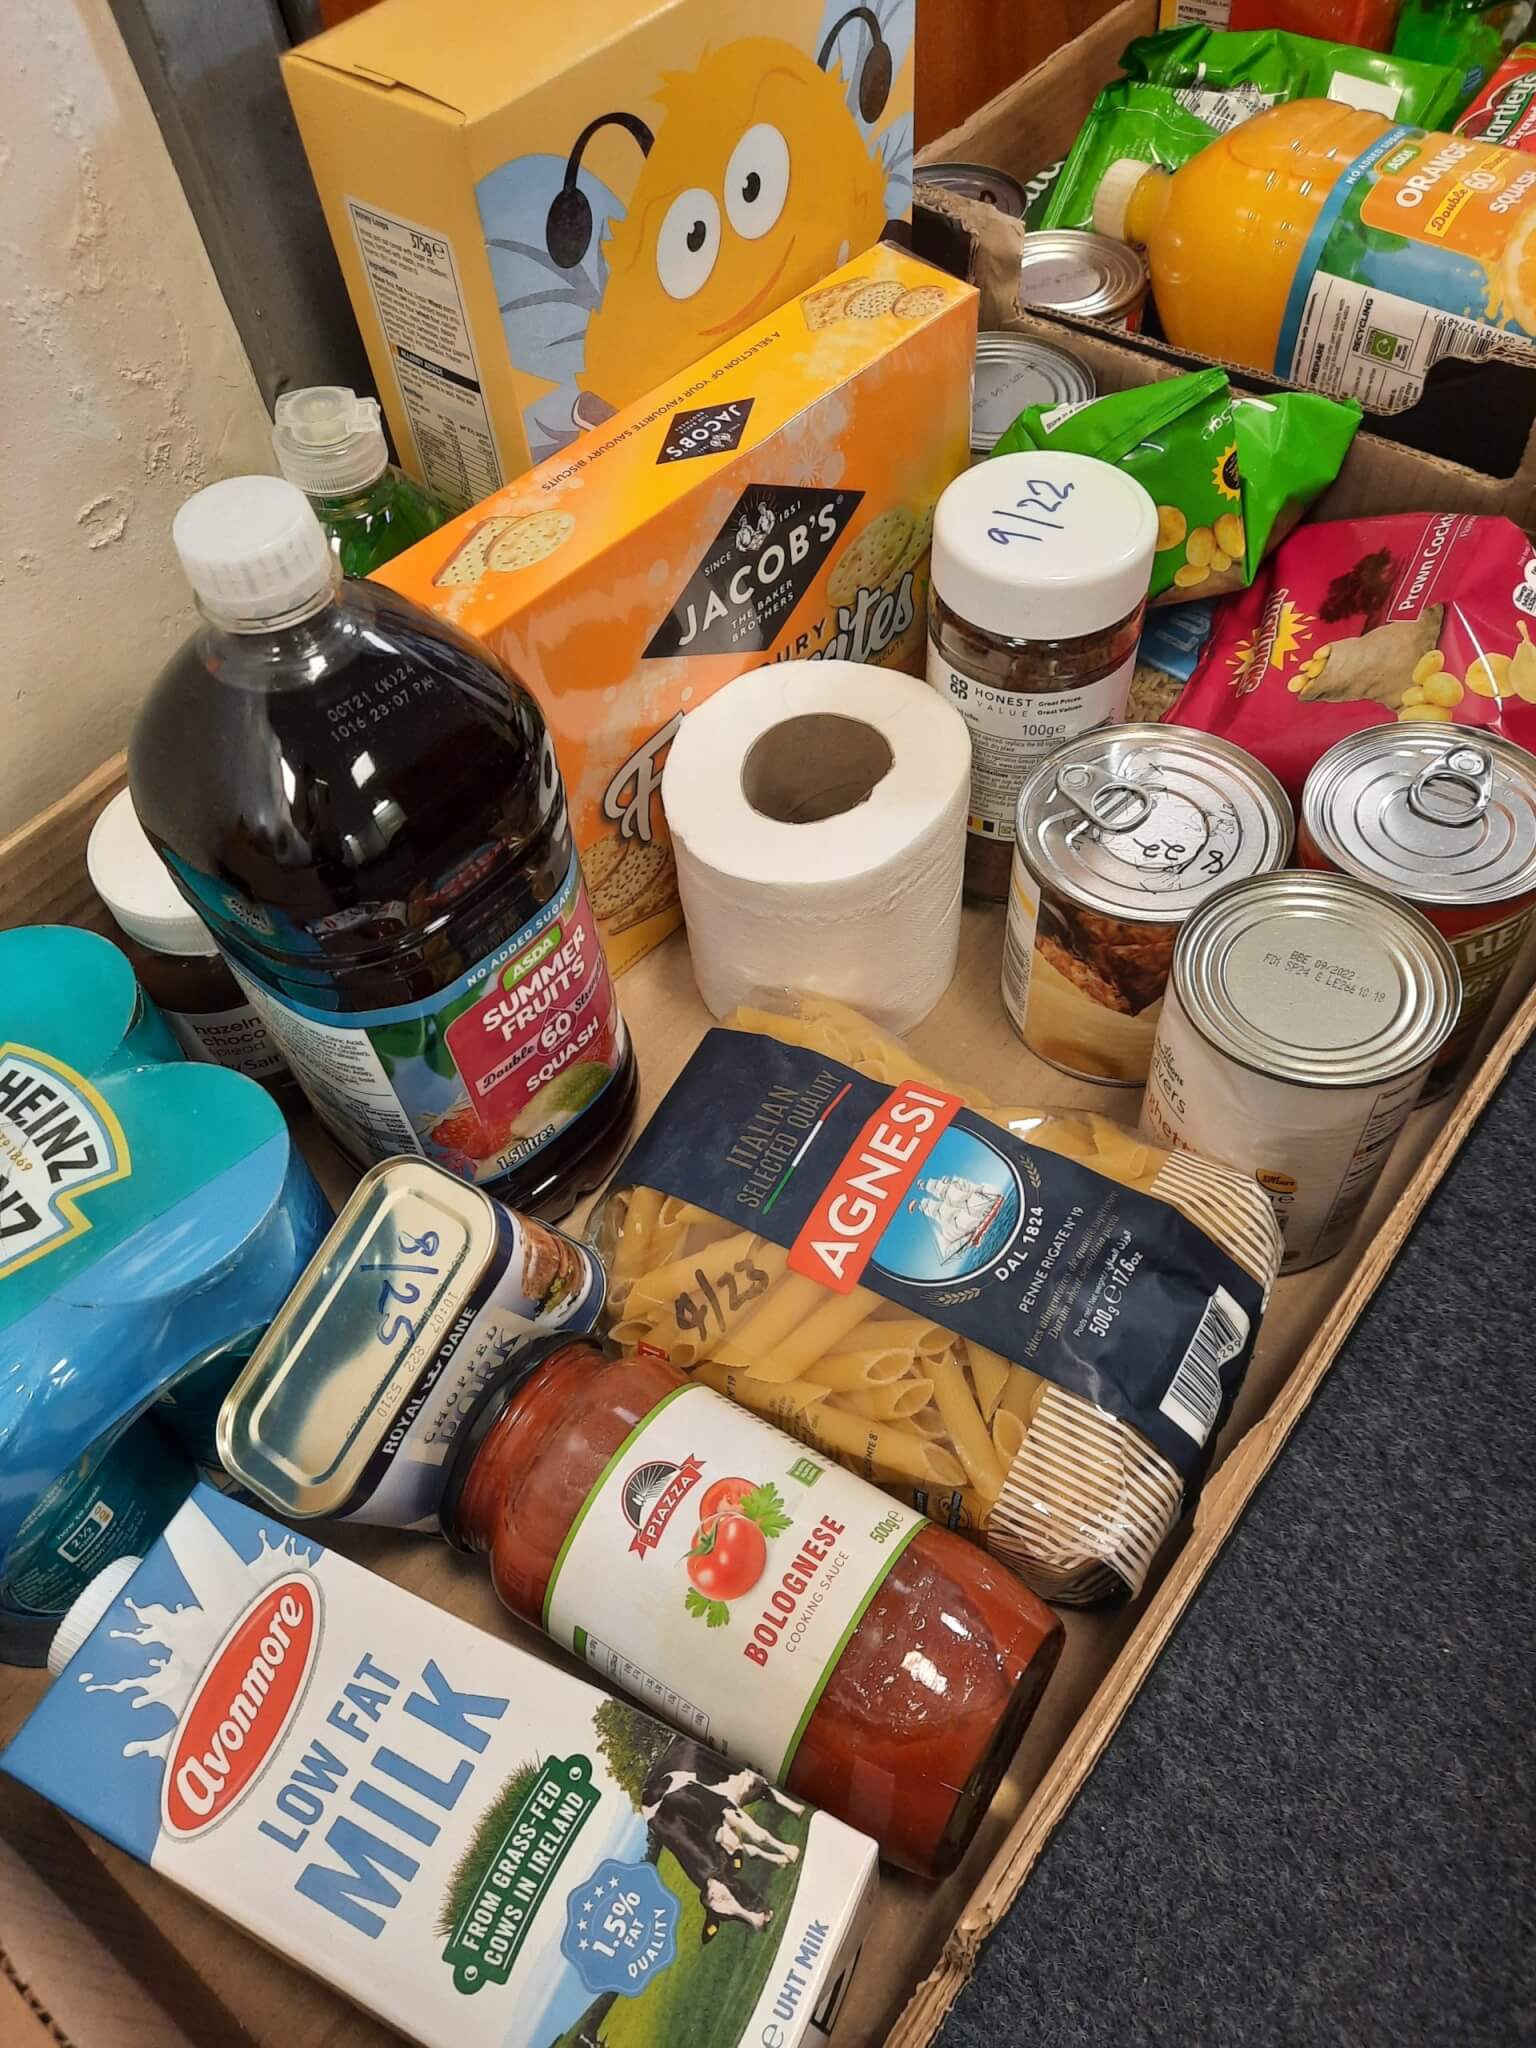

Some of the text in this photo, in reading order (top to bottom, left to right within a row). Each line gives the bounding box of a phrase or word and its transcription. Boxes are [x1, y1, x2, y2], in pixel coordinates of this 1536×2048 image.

[1346, 170, 1361, 184] NO
[1387, 148, 1417, 171] ASDA
[1396, 142, 1476, 208] ORANGE
[1431, 172, 1496, 231] Double 60
[723, 337, 774, 370] SELECTION
[1352, 297, 1374, 353] RECYCLING
[684, 379, 712, 398] YOUR
[711, 369, 725, 380] OF
[1309, 342, 1325, 384] PREPARE
[631, 395, 685, 431] FAVOURITE
[665, 404, 743, 458] JACOB'S
[588, 428, 633, 463] SAVOURY
[541, 461, 588, 491] BISCUITS
[677, 501, 838, 647] JACOB'S
[703, 551, 733, 577] SINCE
[1397, 562, 1435, 613] Prawn
[730, 579, 794, 630] THE BAKER
[730, 592, 795, 643] BROTHERS
[327, 691, 372, 723] OCT21
[330, 718, 368, 743] 1016
[368, 690, 411, 723] 23:07
[974, 686, 1034, 708] HONEST
[976, 700, 1030, 719] VALUE
[1021, 723, 1057, 738] 100g
[466, 971, 487, 988] NO
[486, 932, 532, 972] ADDED
[482, 924, 586, 1032] SUMMER
[511, 935, 555, 981] ASDA
[500, 957, 586, 1042] FRUITS
[201, 1027, 268, 1048] choco
[482, 1012, 573, 1089] Double 60
[526, 1016, 600, 1092] SQUASH
[0, 1069, 99, 1184] HEINZ
[725, 1084, 800, 1171] ITALIAN
[736, 1069, 843, 1209] SELECTED QUALITY
[809, 1089, 947, 1281] AGNESI
[994, 1206, 1045, 1282] DAL 1824
[1018, 1270, 1049, 1314] PENNE
[1040, 1229, 1069, 1270] RIGATE
[1088, 1250, 1145, 1338] 500g 17.6oz
[382, 1306, 477, 1456] ROYAL DANE
[423, 1324, 498, 1445] CHOPPED
[645, 1474, 694, 1540] PIAZZA
[869, 1517, 900, 1545] 500g
[743, 1514, 846, 1668] BOLOGNESE
[785, 1550, 851, 1654] COOKING SAUCE
[258, 1651, 401, 1854] LOW FAT
[294, 1658, 511, 1940] MILK
[462, 1780, 563, 1952] FROM GRASS-FED
[483, 1790, 585, 1967] COWS IN IRELAND
[591, 1890, 641, 1958] 1.5%
[623, 1917, 646, 1949] FAT
[627, 1908, 668, 1979] QUALITY
[772, 1968, 807, 2021] UHT
[794, 1919, 830, 1971] Milk
